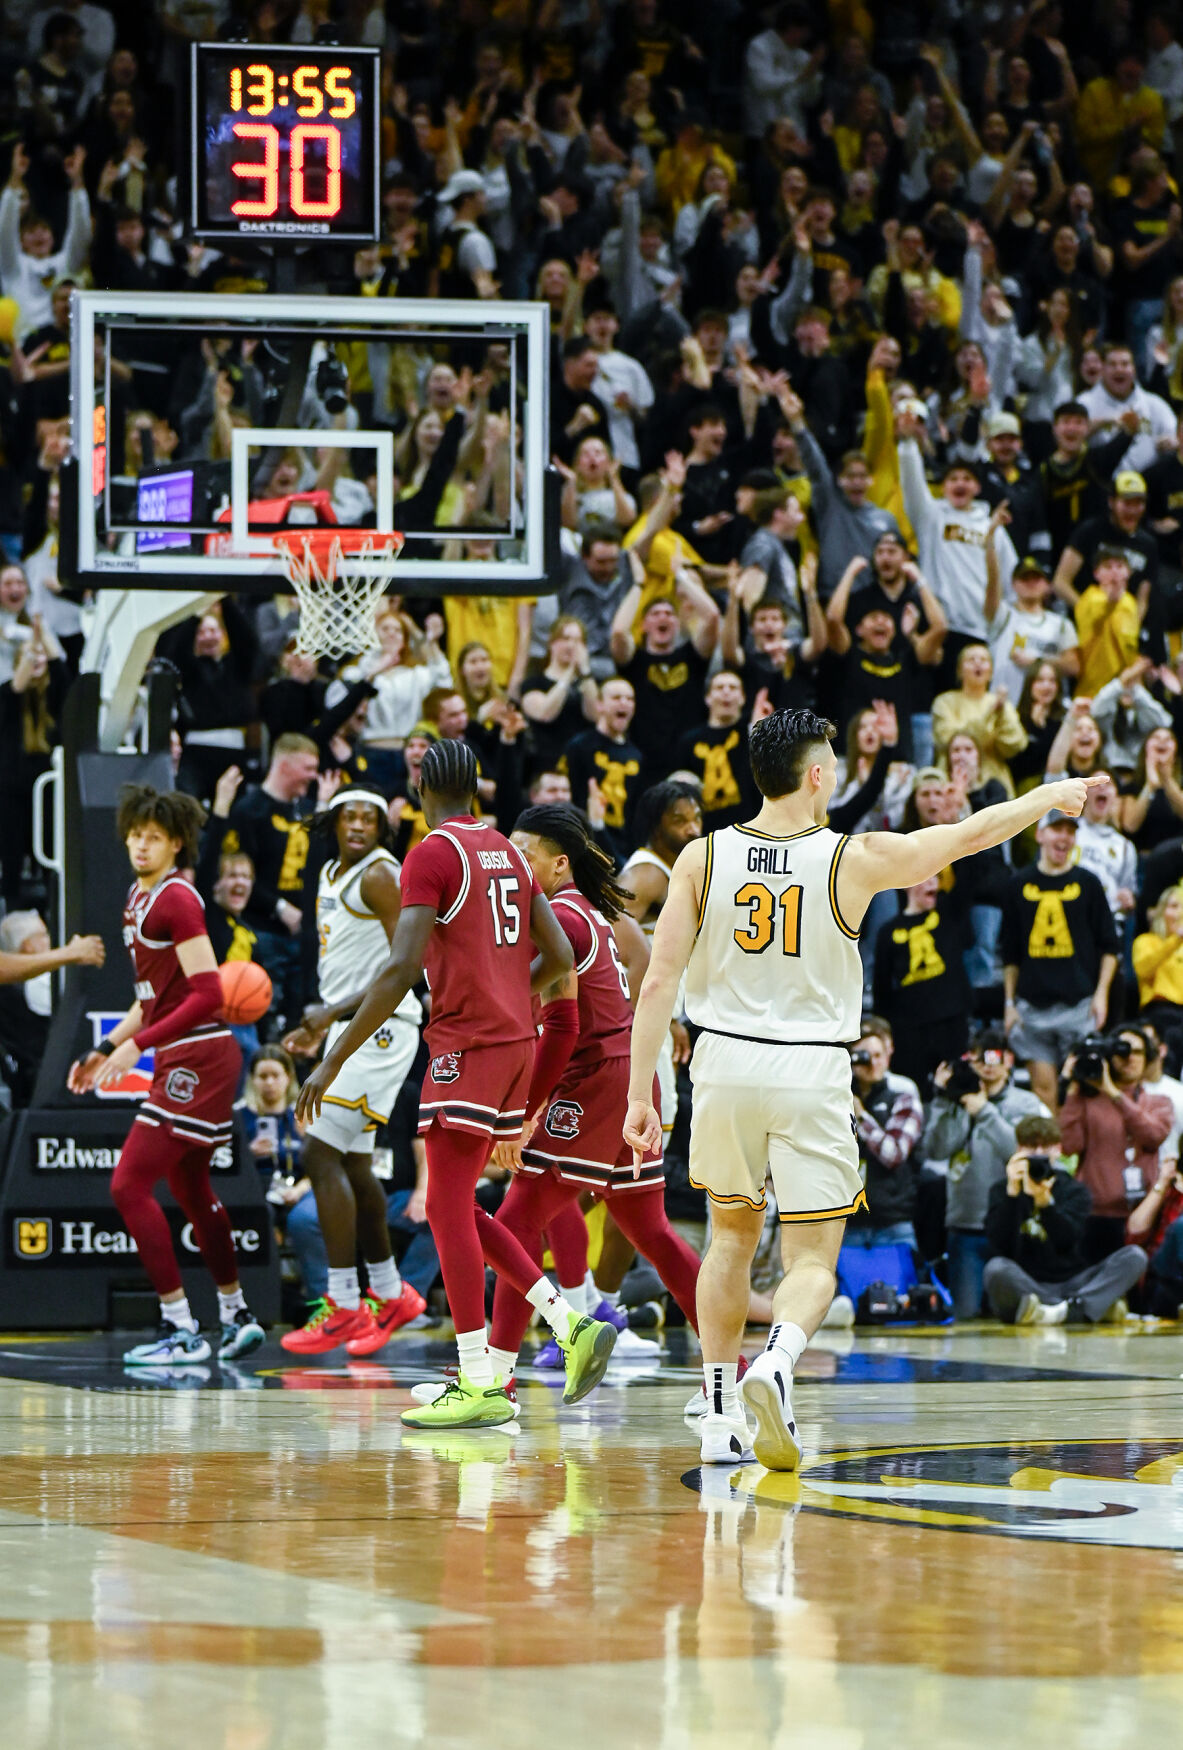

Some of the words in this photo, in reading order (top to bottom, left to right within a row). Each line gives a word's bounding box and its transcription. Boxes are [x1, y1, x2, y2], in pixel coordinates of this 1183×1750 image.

[230, 64, 356, 118] 13:55
[230, 123, 342, 217] 30
[239, 221, 331, 234] DAKTRONICS
[476, 850, 514, 870] UGUSUK
[747, 846, 793, 875] GRILL
[486, 876, 520, 947] 15
[733, 882, 804, 958] 31
[38, 1137, 123, 1169] Edwar
[181, 1221, 260, 1253] Cre
